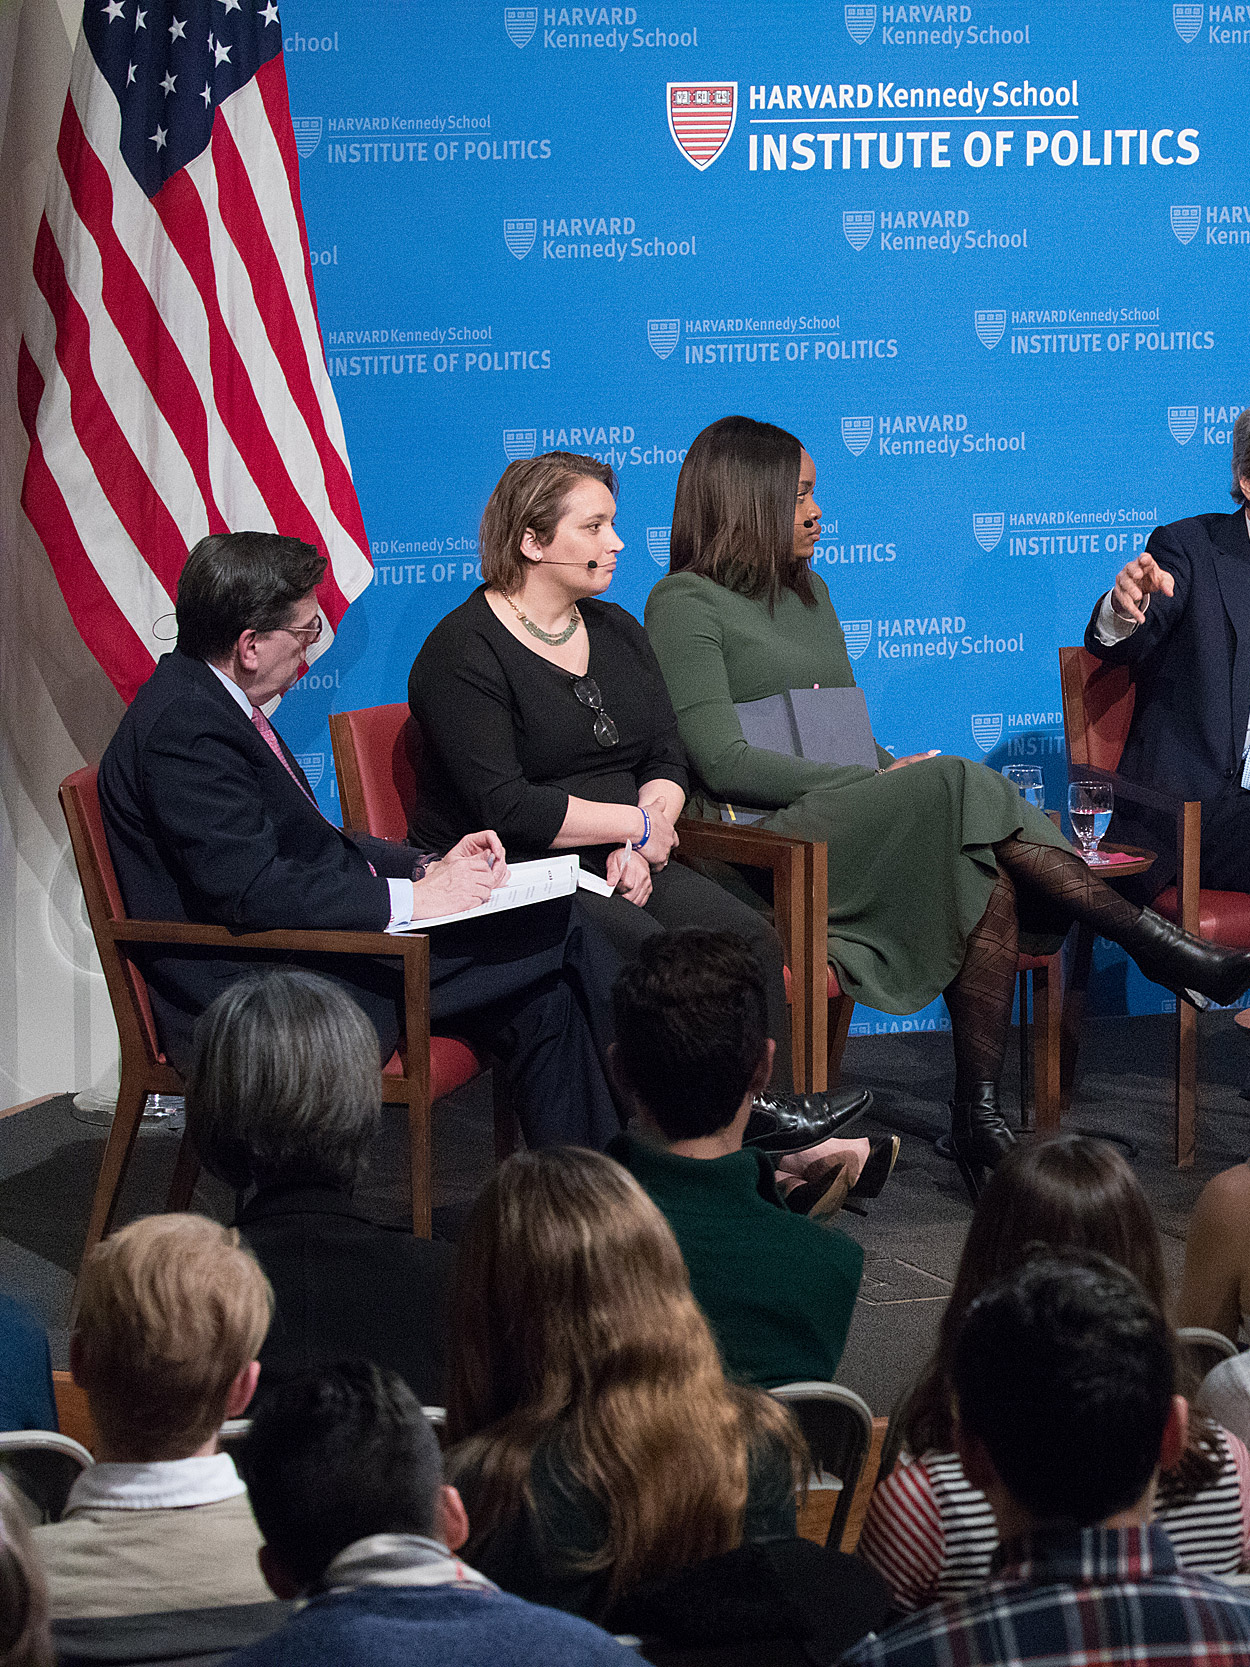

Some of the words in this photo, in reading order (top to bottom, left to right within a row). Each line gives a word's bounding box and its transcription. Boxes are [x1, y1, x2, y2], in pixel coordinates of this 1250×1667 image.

[543, 6, 638, 26] HARVARD
[882, 4, 972, 24] HARVARD
[284, 31, 339, 52] chool
[543, 27, 630, 53] Kennedy
[631, 26, 698, 48] School
[882, 24, 965, 50] Kennedy
[966, 24, 1031, 45] School
[749, 83, 874, 110] HARVARD
[877, 80, 990, 115] Kennedy
[992, 79, 1079, 107] School
[328, 117, 390, 132] HARVARD
[391, 114, 447, 133] Kennedy
[447, 114, 491, 130] School
[327, 142, 429, 164] INSTITUTE
[433, 141, 459, 162] OF
[464, 138, 552, 161] POLITICS
[748, 131, 951, 171] INSTITUTE
[963, 130, 1015, 168] OF
[1026, 128, 1200, 167] POLITICS
[542, 216, 636, 237] HARVARD
[880, 209, 970, 229] HARVARD
[542, 237, 628, 263] Kennedy
[630, 235, 697, 257] School
[880, 229, 963, 255] Kennedy
[964, 228, 1028, 250] School
[310, 245, 338, 266] ool
[685, 318, 744, 333] HARVARD
[744, 315, 798, 334] Kennedy
[798, 314, 841, 330] School
[1011, 309, 1068, 324] HARVARD
[1068, 307, 1119, 325] Kennedy
[1119, 306, 1160, 322] School
[328, 329, 390, 345] HARVARD
[390, 326, 447, 345] Kennedy
[447, 325, 493, 341] School
[1010, 333, 1102, 355] INSTITUTE
[1106, 332, 1131, 352] OF
[1134, 330, 1215, 351] POLITICS
[685, 342, 780, 365] INSTITUTE
[785, 341, 809, 362] OF
[814, 338, 899, 360] POLITICS
[328, 353, 429, 378] INSTITUTE
[433, 352, 460, 373] OF
[465, 349, 551, 372] POLITICS
[878, 413, 968, 435] HARVARD
[542, 425, 636, 447] HARVARD
[879, 433, 961, 458] Kennedy
[962, 431, 1026, 453] School
[630, 445, 688, 466] Schoo
[821, 520, 838, 534] ool
[1009, 511, 1066, 526] HARVARD
[1066, 508, 1117, 526] Kennedy
[1117, 506, 1158, 522] School
[390, 537, 445, 555] Kennedy
[446, 536, 477, 551] Scho
[812, 542, 898, 566] POLITICS
[1009, 534, 1100, 557] INSTITUTE
[1104, 533, 1128, 553] OF
[374, 564, 425, 586] ITUTE
[431, 562, 457, 583] OF
[877, 616, 966, 638] HARVARD
[877, 636, 959, 660] Kennedy
[961, 632, 1025, 655] School
[1007, 711, 1063, 727] HARVARD
[1007, 735, 1064, 757] INSTIT
